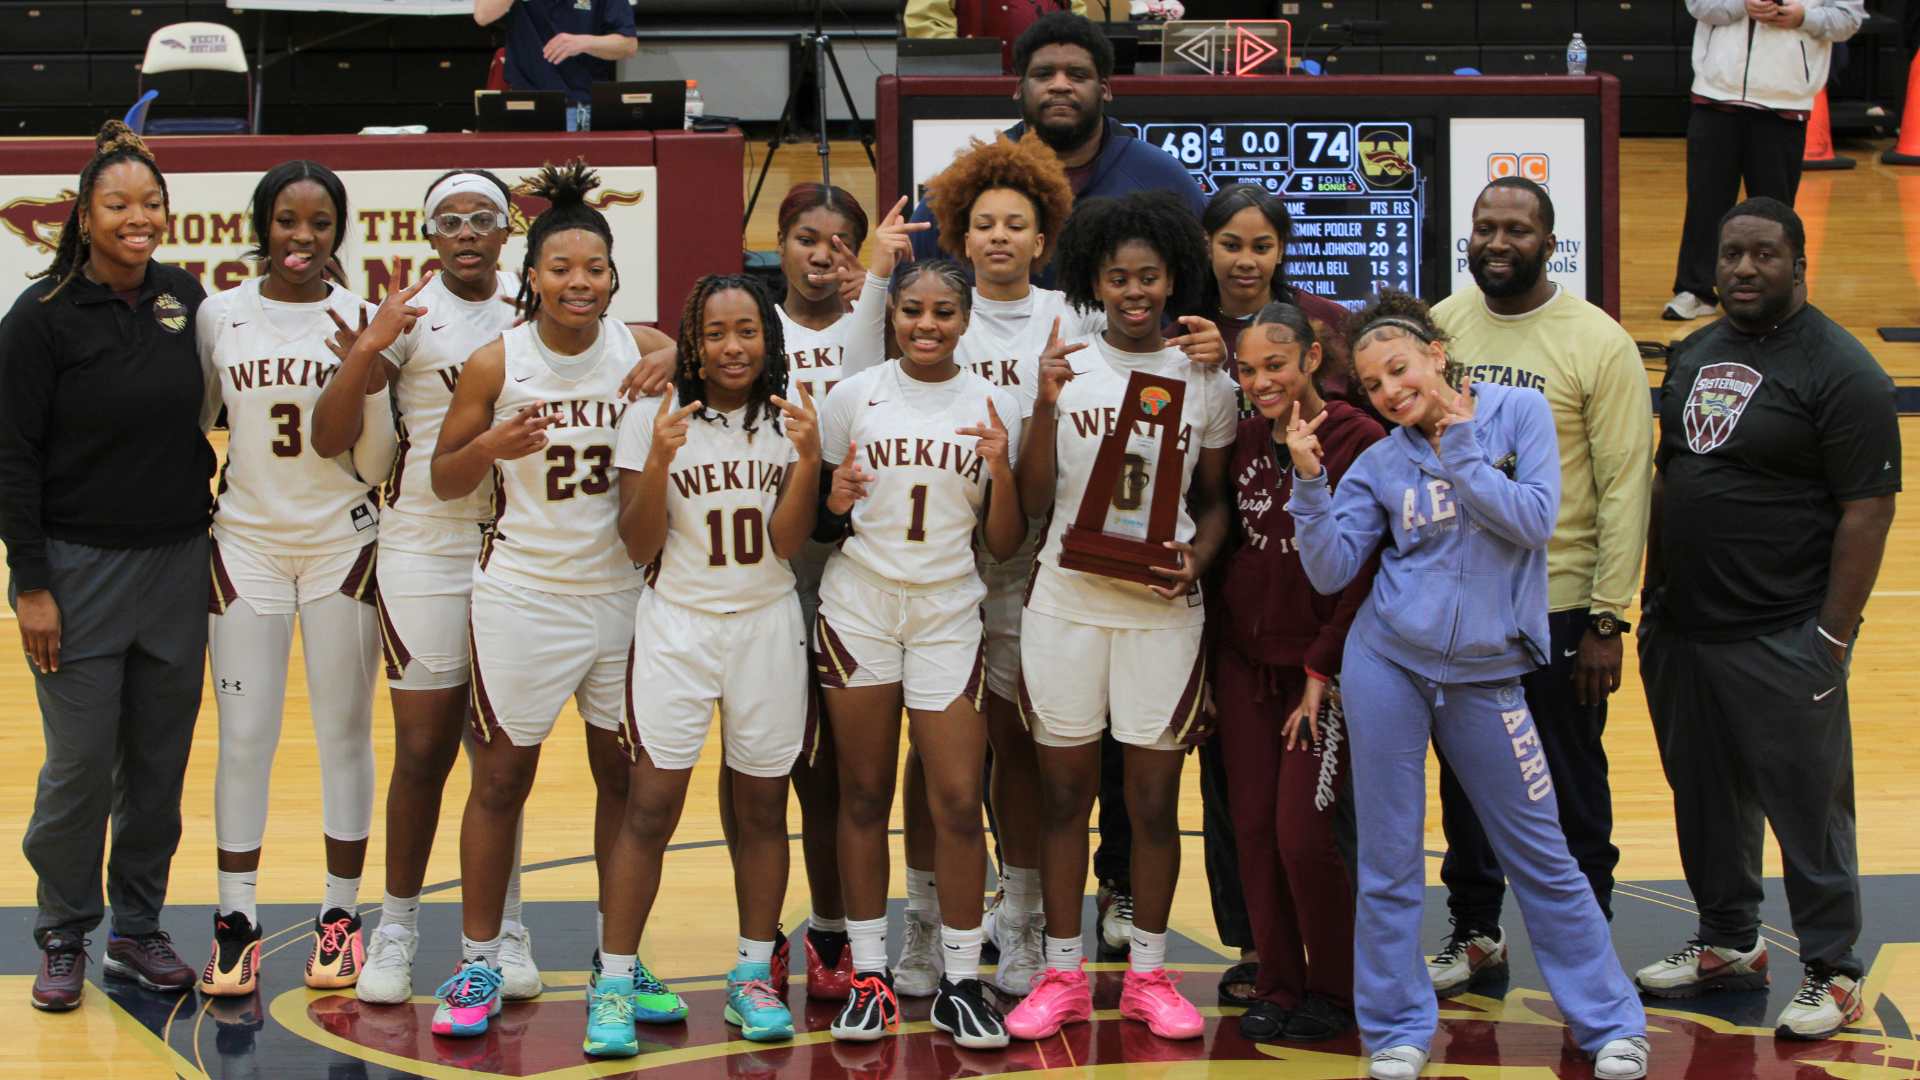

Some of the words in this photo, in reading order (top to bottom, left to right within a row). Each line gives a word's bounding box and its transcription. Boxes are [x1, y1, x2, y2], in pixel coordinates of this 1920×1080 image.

[190, 35, 226, 44] WEKIVA
[1209, 127, 1224, 144] 4
[1241, 131, 1280, 154] 0.0
[1161, 132, 1203, 164] 68
[1306, 131, 1350, 163] 74
[1219, 162, 1227, 171] 1
[1241, 162, 1259, 170] TOL
[1301, 176, 1314, 191] 5
[1317, 176, 1354, 184] FOULS
[1369, 201, 1388, 215] PTS
[1393, 201, 1410, 215] FLS
[356, 208, 431, 244] TH
[1324, 222, 1362, 237] POOLER
[1375, 222, 1387, 238] 5
[1396, 222, 1408, 237] 2
[1322, 242, 1367, 256] JOHNSON
[1368, 241, 1389, 257] 20
[1396, 241, 1408, 256] 4
[1326, 261, 1349, 276] BELL
[1370, 261, 1389, 276] 15
[1397, 260, 1408, 276] 3
[1315, 280, 1337, 295] HILL
[228, 357, 341, 392] WEKIV
[1695, 378, 1753, 398] SISTERHOOD
[269, 401, 303, 459] 3
[865, 437, 985, 486] WEKIVA
[544, 442, 614, 504] 23
[669, 459, 784, 500] WEKIVA
[904, 482, 930, 545] 1
[703, 505, 764, 568] 10
[1501, 708, 1552, 802] AERO
